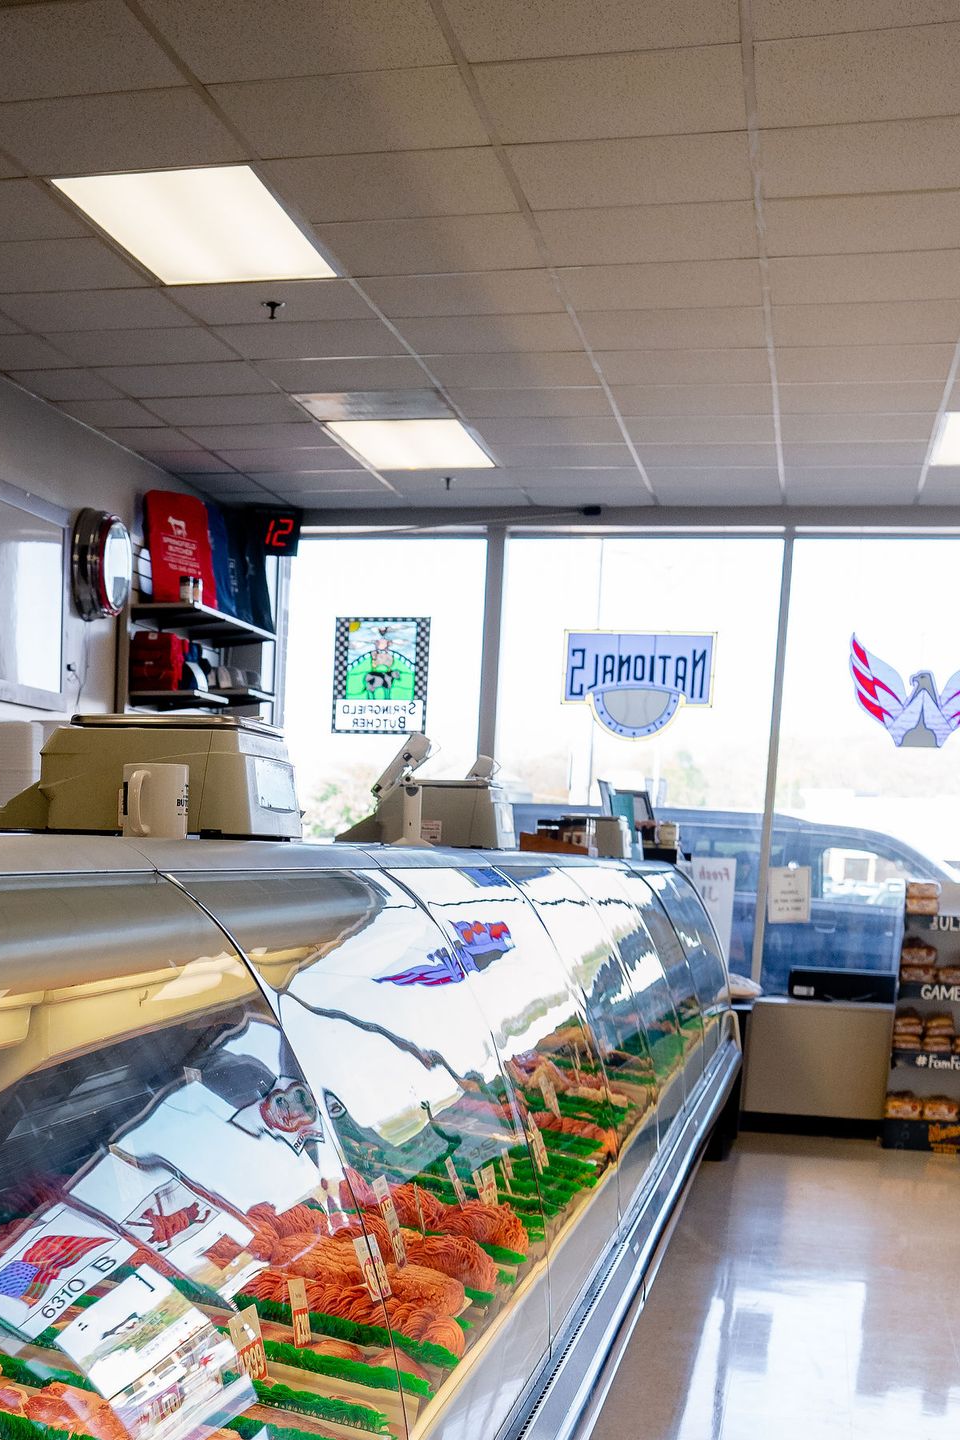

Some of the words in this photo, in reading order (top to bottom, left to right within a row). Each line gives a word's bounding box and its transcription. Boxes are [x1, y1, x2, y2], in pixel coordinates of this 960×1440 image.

[265, 518, 294, 546] 12
[41, 1278, 86, 1319] 6310
[91, 1256, 117, 1273] B
